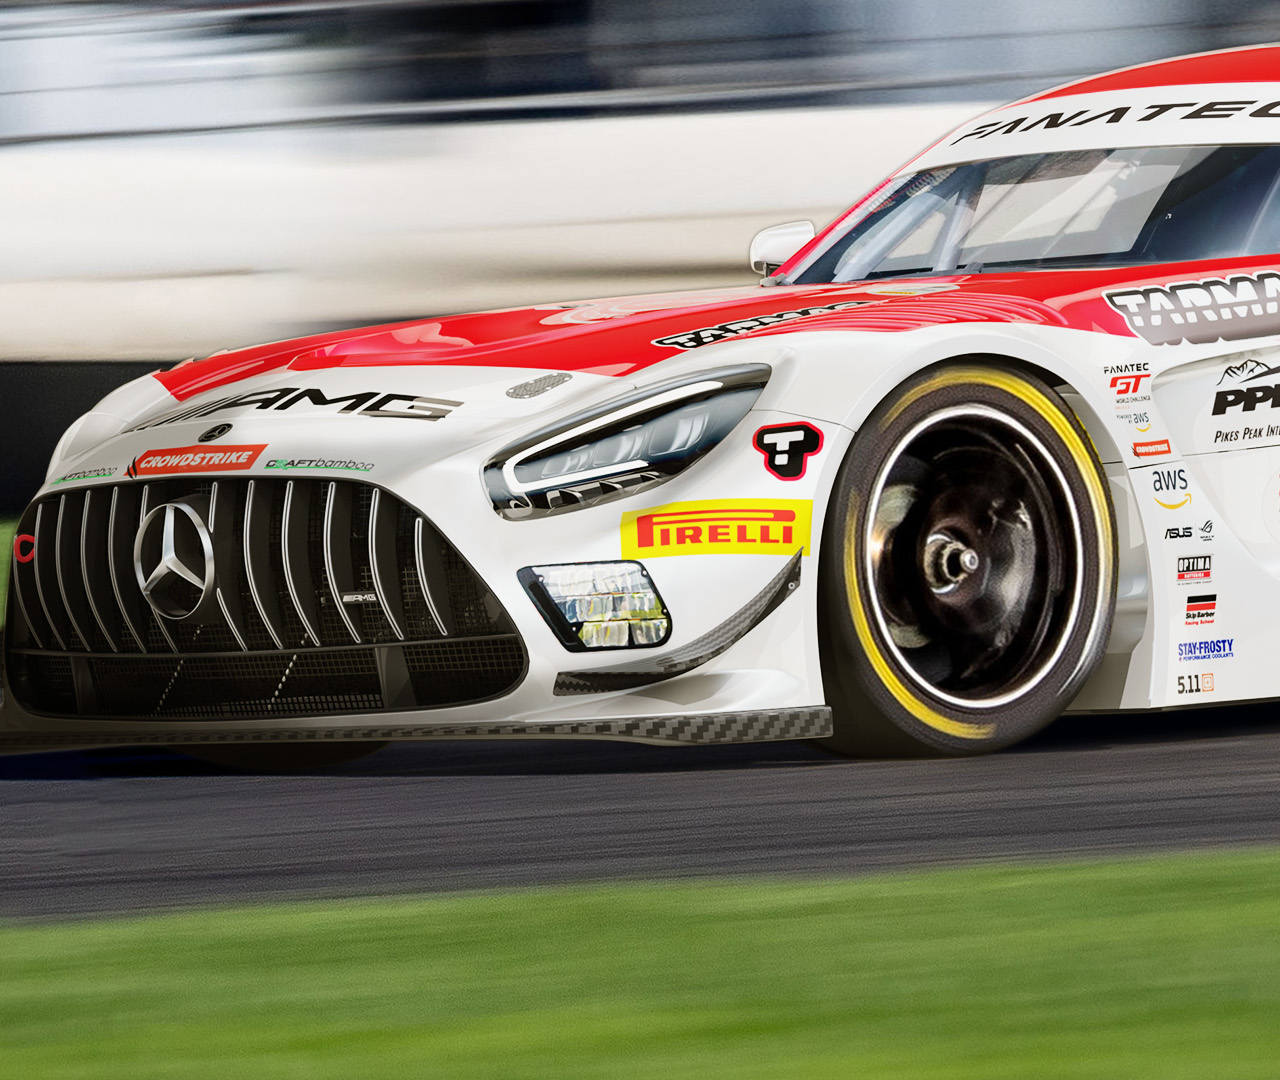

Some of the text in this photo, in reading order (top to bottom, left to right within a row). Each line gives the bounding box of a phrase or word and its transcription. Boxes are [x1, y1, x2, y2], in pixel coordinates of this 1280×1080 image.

[1104, 362, 1150, 374] FANATEC
[197, 386, 465, 422] AMG
[1133, 412, 1150, 424] aws
[1214, 430, 1239, 443] PIKES
[1243, 427, 1263, 440] PEAK
[140, 451, 253, 469] CROWDSTRIKE
[1153, 469, 1188, 491] aws
[636, 509, 796, 548] PIRELLI
[1165, 527, 1193, 539] ASUS
[1178, 557, 1210, 571] OPTIMA
[1178, 675, 1201, 694] 5.11
